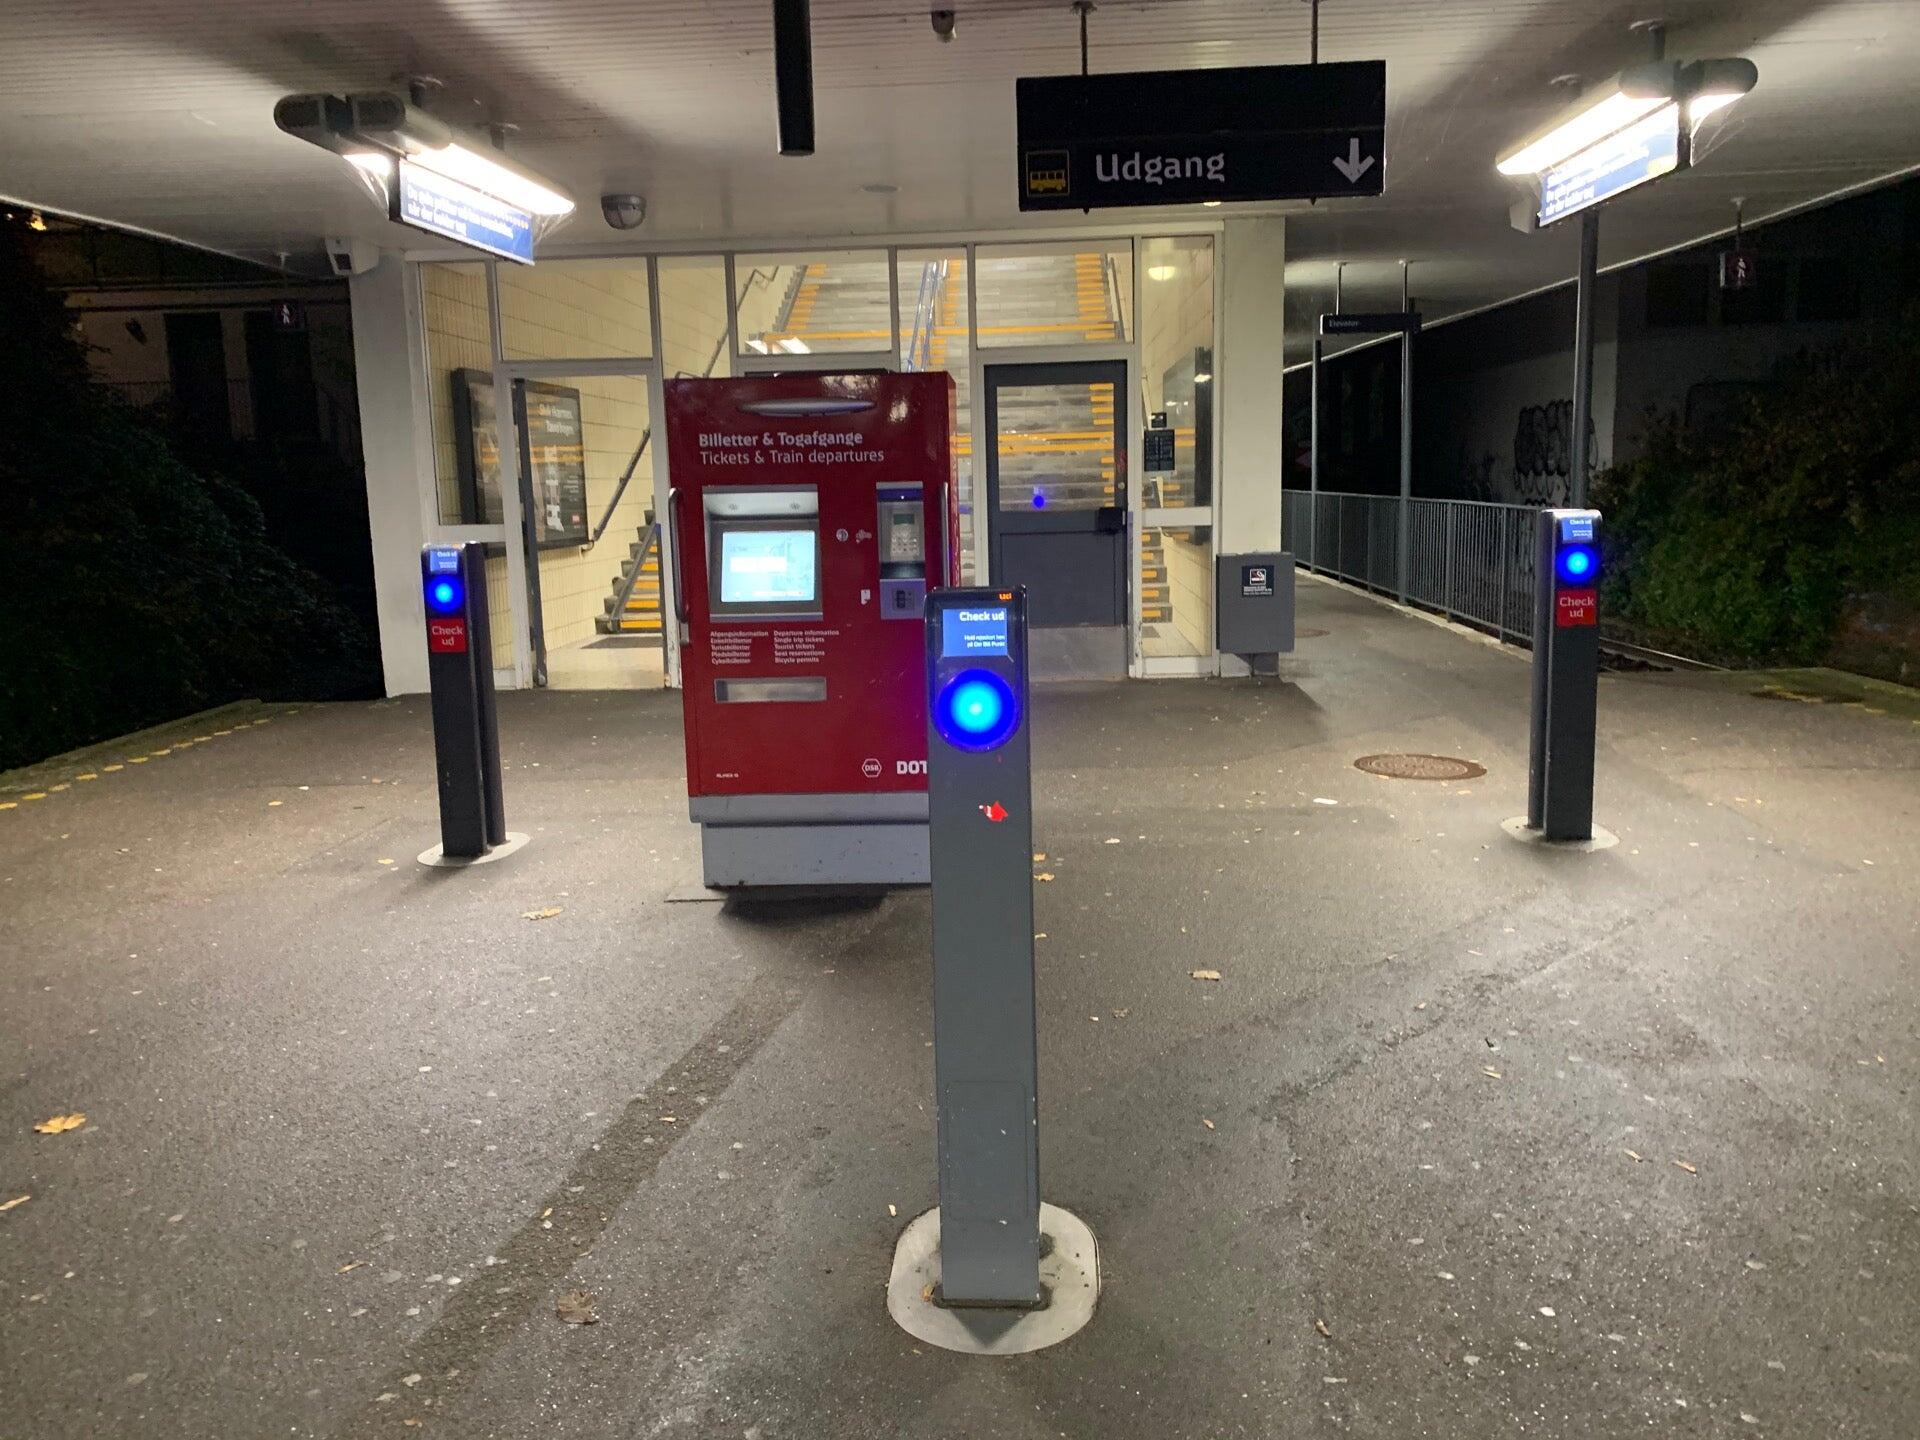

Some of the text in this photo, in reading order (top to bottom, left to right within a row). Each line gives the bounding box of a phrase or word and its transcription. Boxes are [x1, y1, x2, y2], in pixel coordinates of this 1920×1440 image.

[1096, 152, 1225, 185] Udgang
[699, 431, 863, 448] Billetter & Togafgange
[700, 449, 885, 465] Tickets & Train departures
[1559, 596, 1595, 607] Check
[959, 611, 1005, 621] Check ud
[1569, 608, 1584, 618] ud
[431, 625, 464, 636] Check
[441, 637, 455, 646] ud
[864, 764, 879, 772] DSB
[896, 760, 928, 775] DOT
